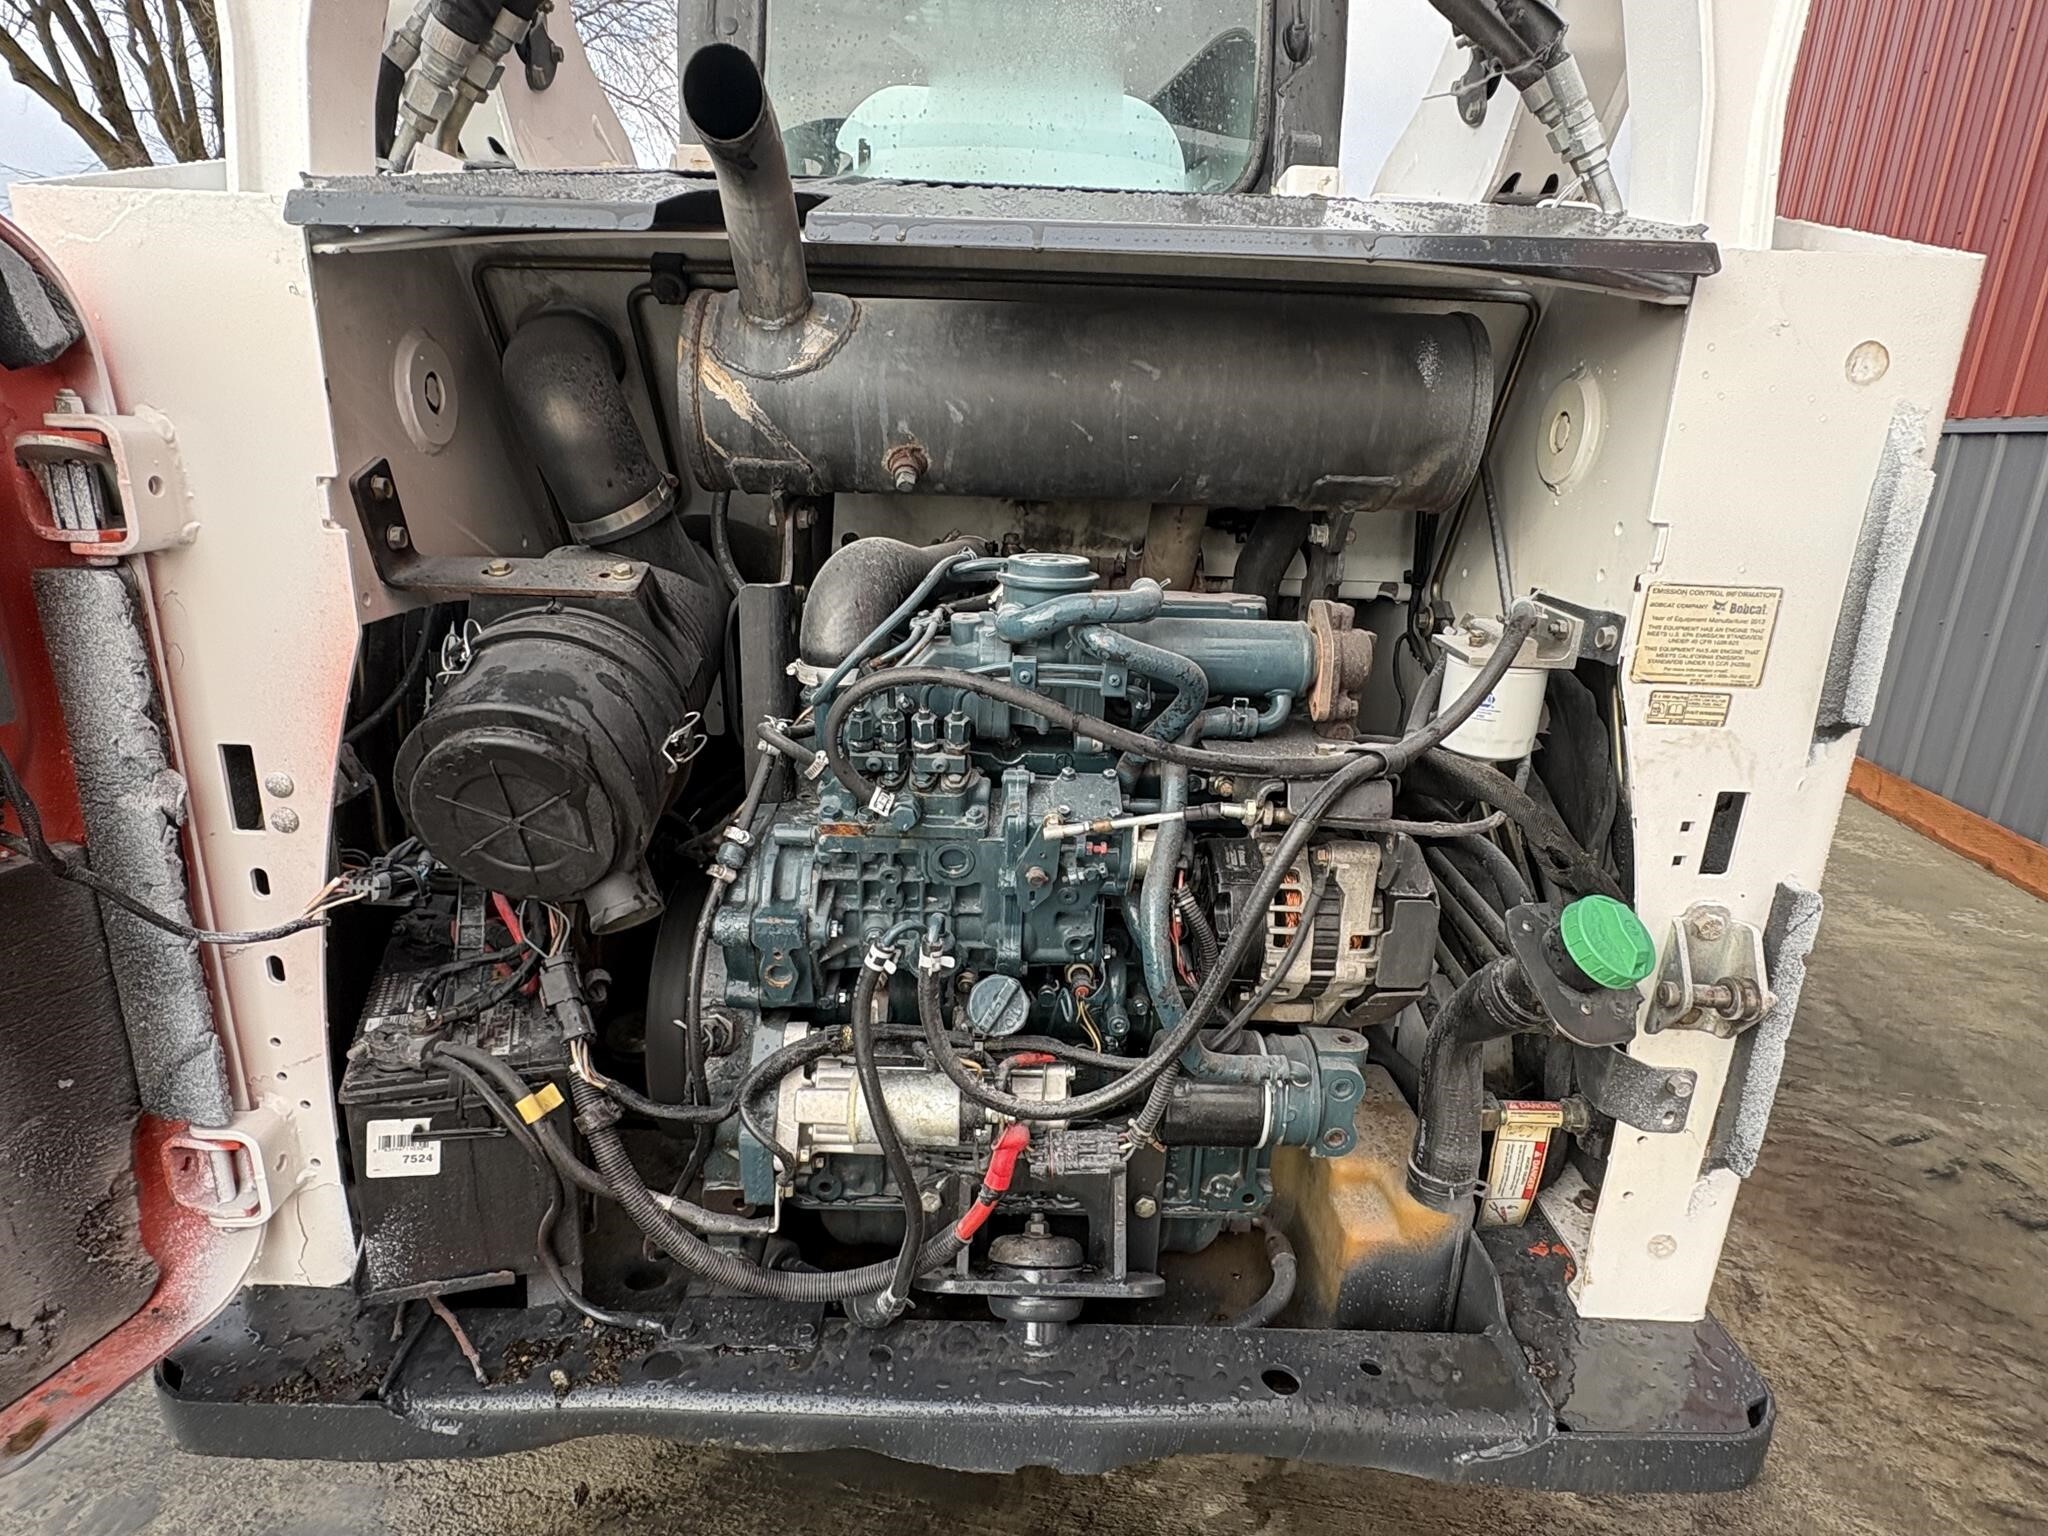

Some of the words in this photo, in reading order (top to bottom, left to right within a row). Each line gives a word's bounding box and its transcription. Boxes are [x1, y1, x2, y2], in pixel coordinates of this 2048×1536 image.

[1652, 588, 1687, 596] EMISSION
[1729, 603, 1767, 615] Bobcat
[1519, 1102, 1558, 1110] DANGER
[402, 1154, 433, 1164] 7524
[1526, 1160, 1541, 1190] DANGER
